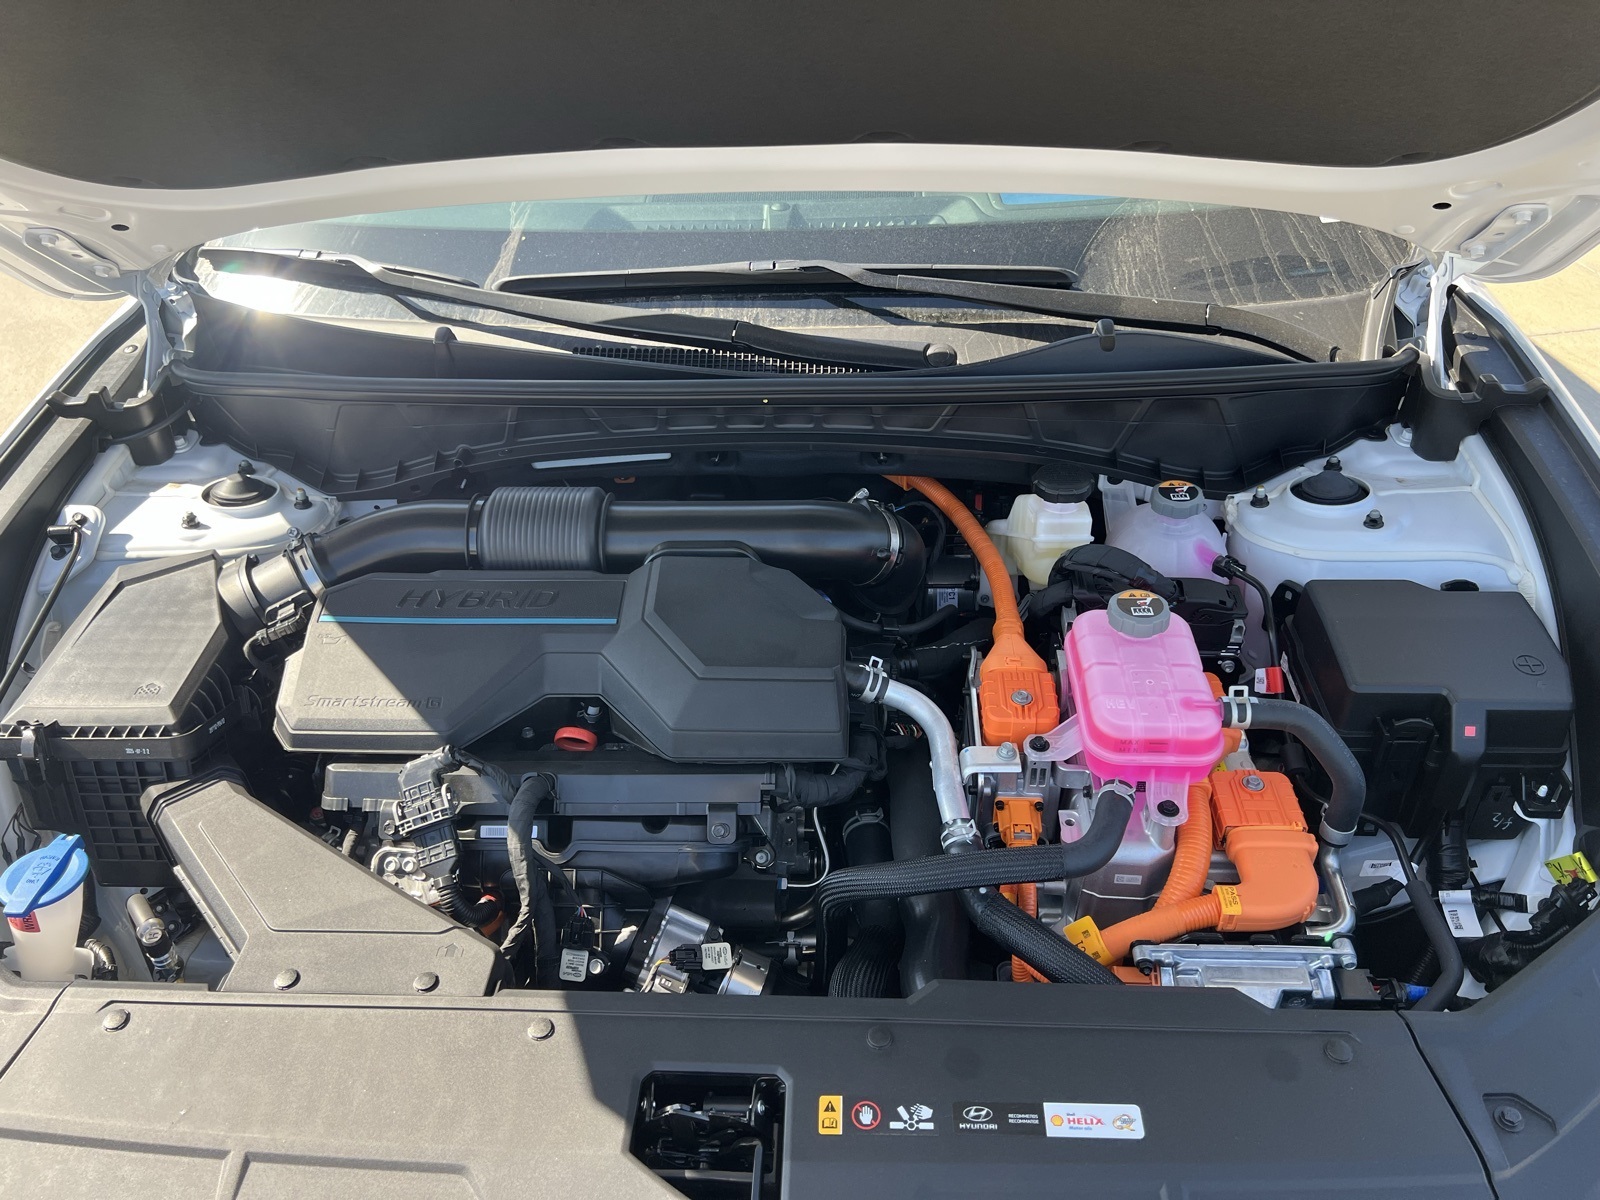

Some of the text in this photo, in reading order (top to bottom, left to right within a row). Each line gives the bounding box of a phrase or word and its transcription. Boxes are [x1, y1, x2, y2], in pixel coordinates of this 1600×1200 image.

[395, 588, 559, 610] HYBRID
[303, 694, 422, 708] Smartstream
[1228, 886, 1239, 906] PASS
[959, 1122, 998, 1130] HYUNDAI
[1067, 1117, 1104, 1125] HELIX
